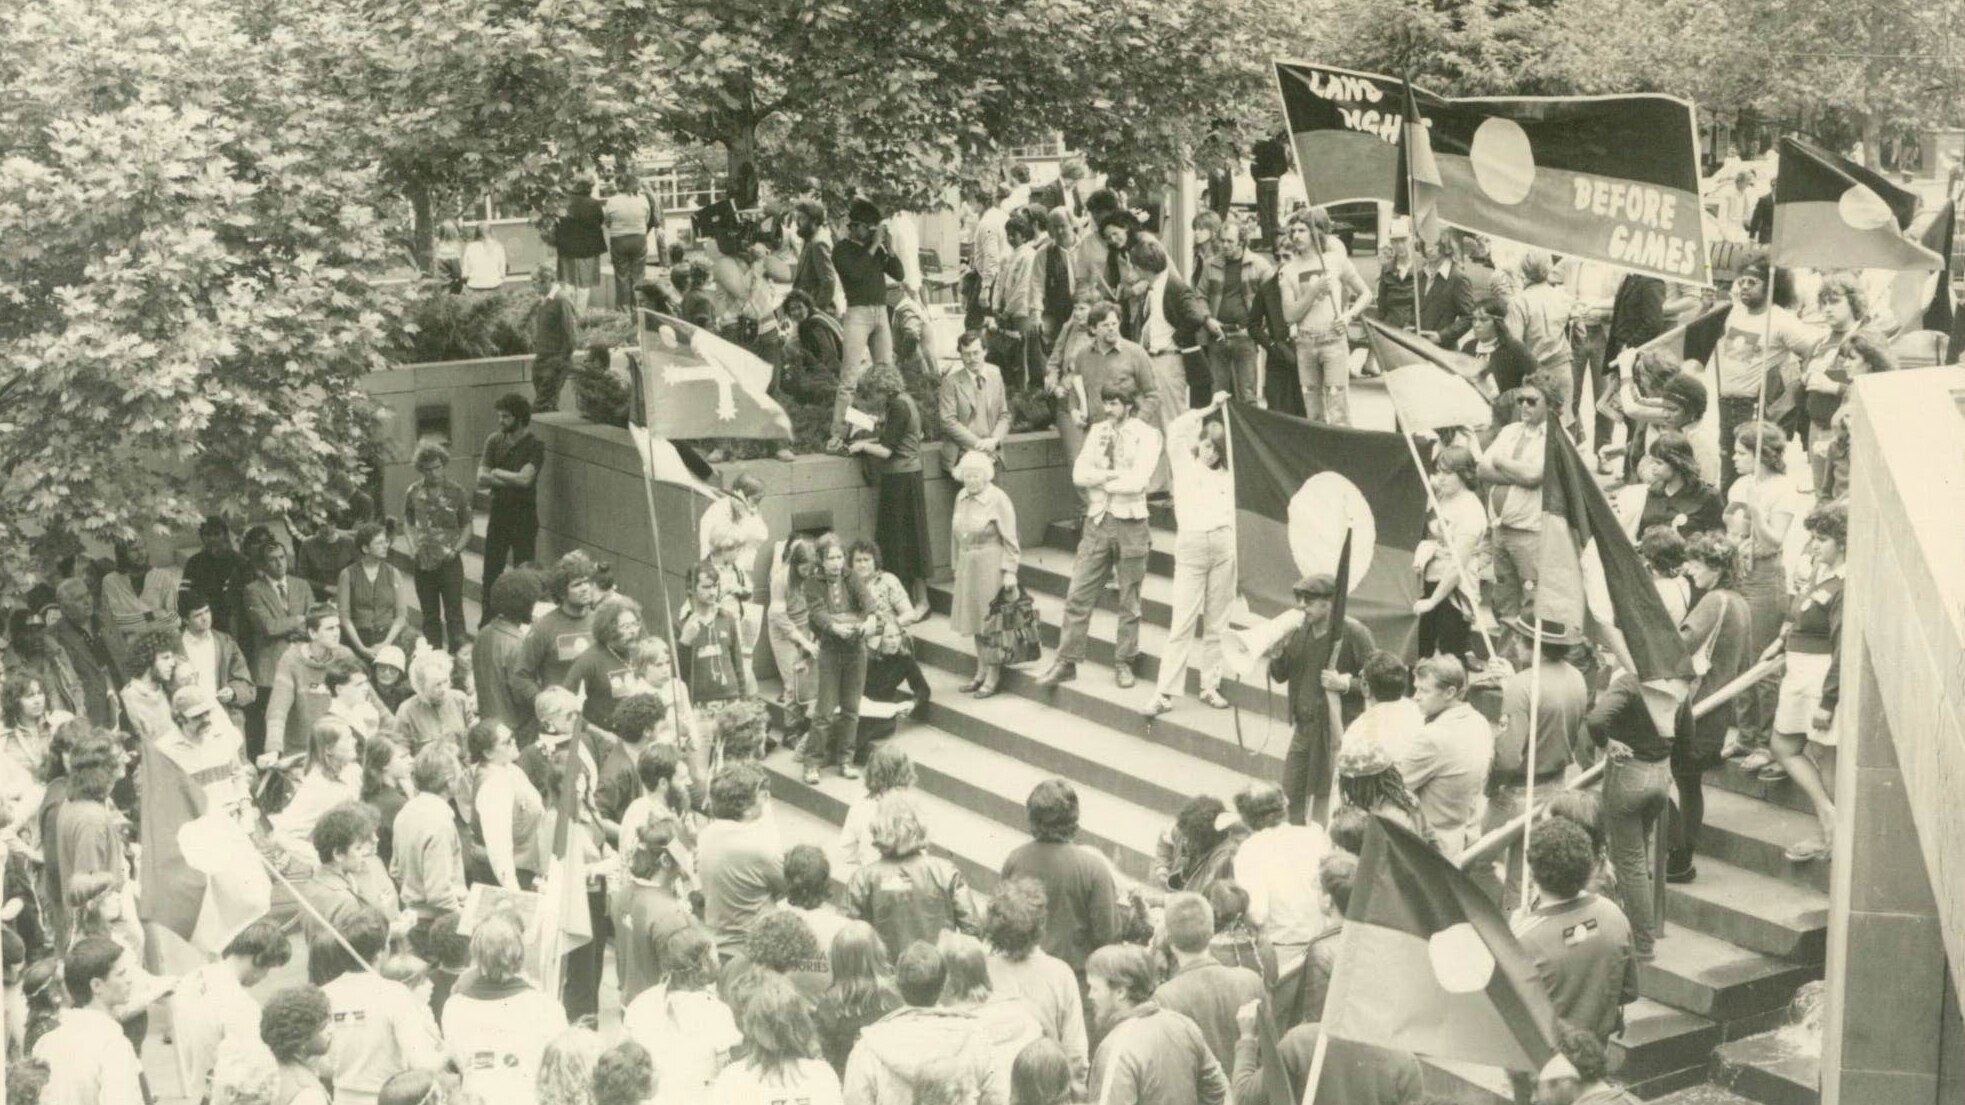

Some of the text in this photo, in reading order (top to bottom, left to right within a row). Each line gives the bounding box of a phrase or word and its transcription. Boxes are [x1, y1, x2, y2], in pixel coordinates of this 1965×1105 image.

[1308, 70, 1383, 103] LAND
[1574, 177, 1677, 230] BEFORE
[1608, 224, 1697, 275] GAMES
